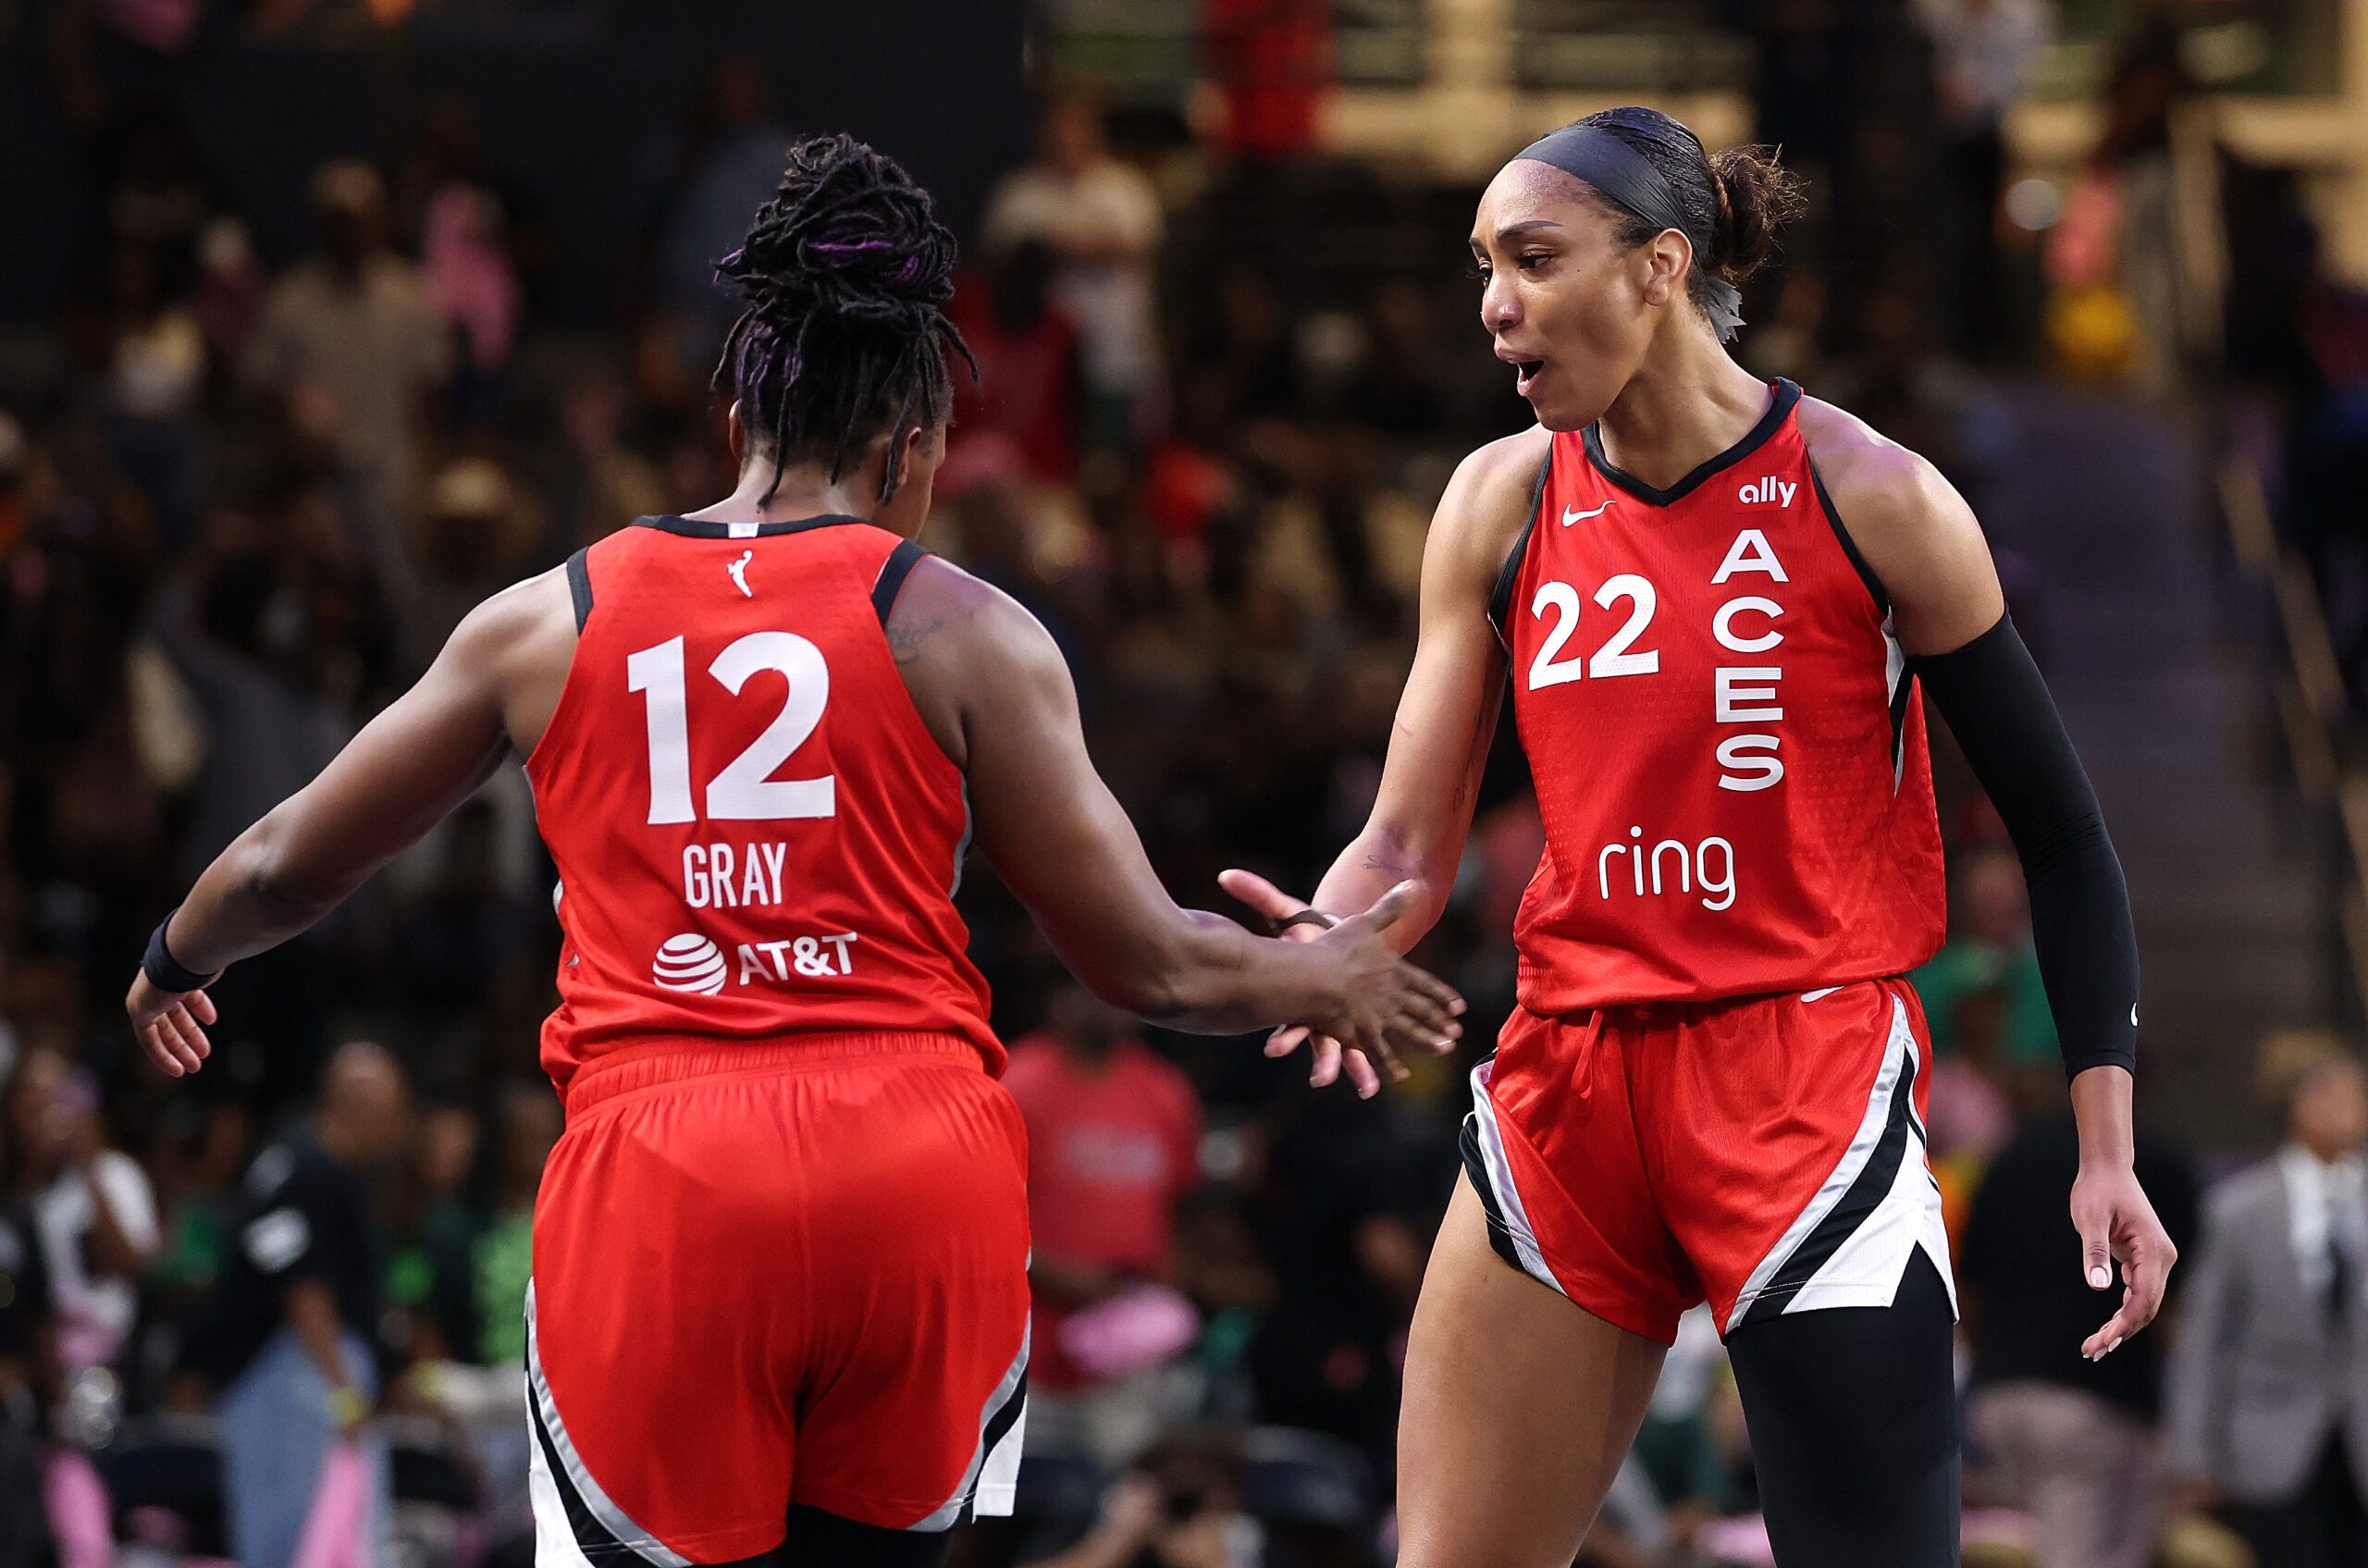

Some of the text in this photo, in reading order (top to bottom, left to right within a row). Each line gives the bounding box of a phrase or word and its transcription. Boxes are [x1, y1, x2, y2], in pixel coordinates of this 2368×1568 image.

[1738, 475, 1797, 508] ally
[1528, 574, 1659, 691] 22
[1710, 527, 1790, 792] ACES
[626, 630, 836, 825] 12
[683, 842, 787, 908] GRAY
[1598, 825, 1736, 911] ring
[737, 932, 857, 986] AT&T
